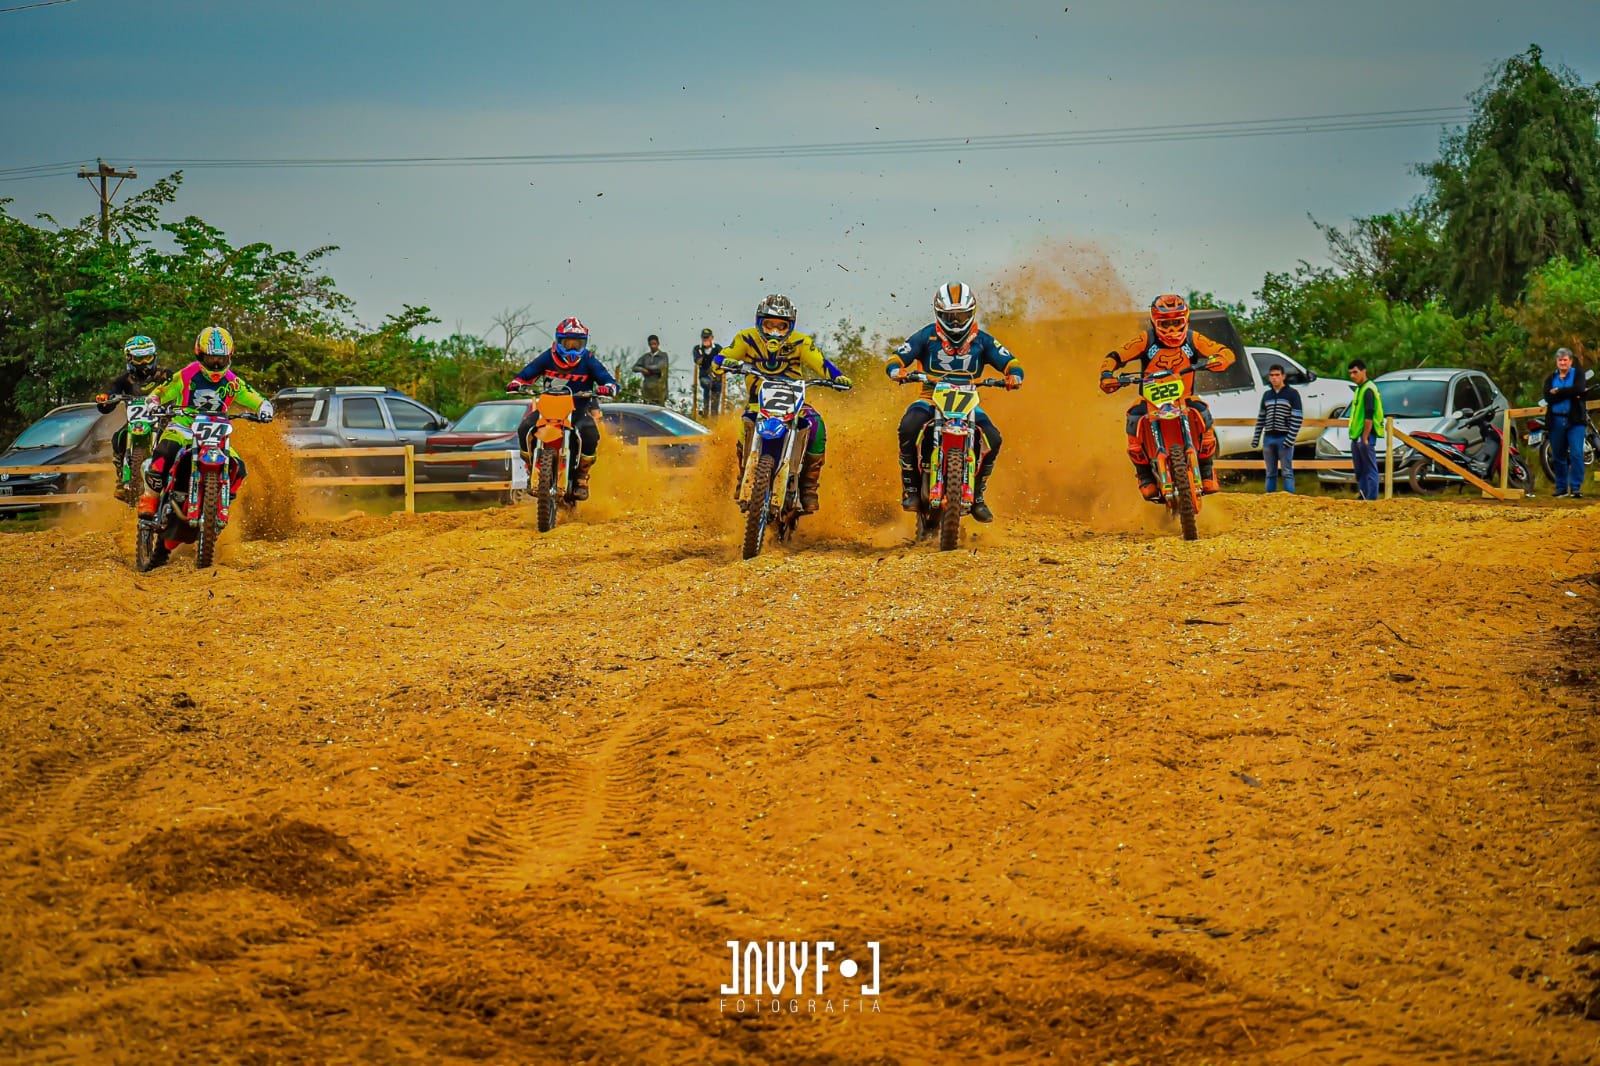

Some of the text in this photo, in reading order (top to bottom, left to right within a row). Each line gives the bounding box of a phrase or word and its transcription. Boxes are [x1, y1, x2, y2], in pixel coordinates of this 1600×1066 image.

[764, 391, 795, 411] 2
[943, 390, 974, 412] 17
[1150, 383, 1180, 401] 222
[195, 422, 229, 441] 54
